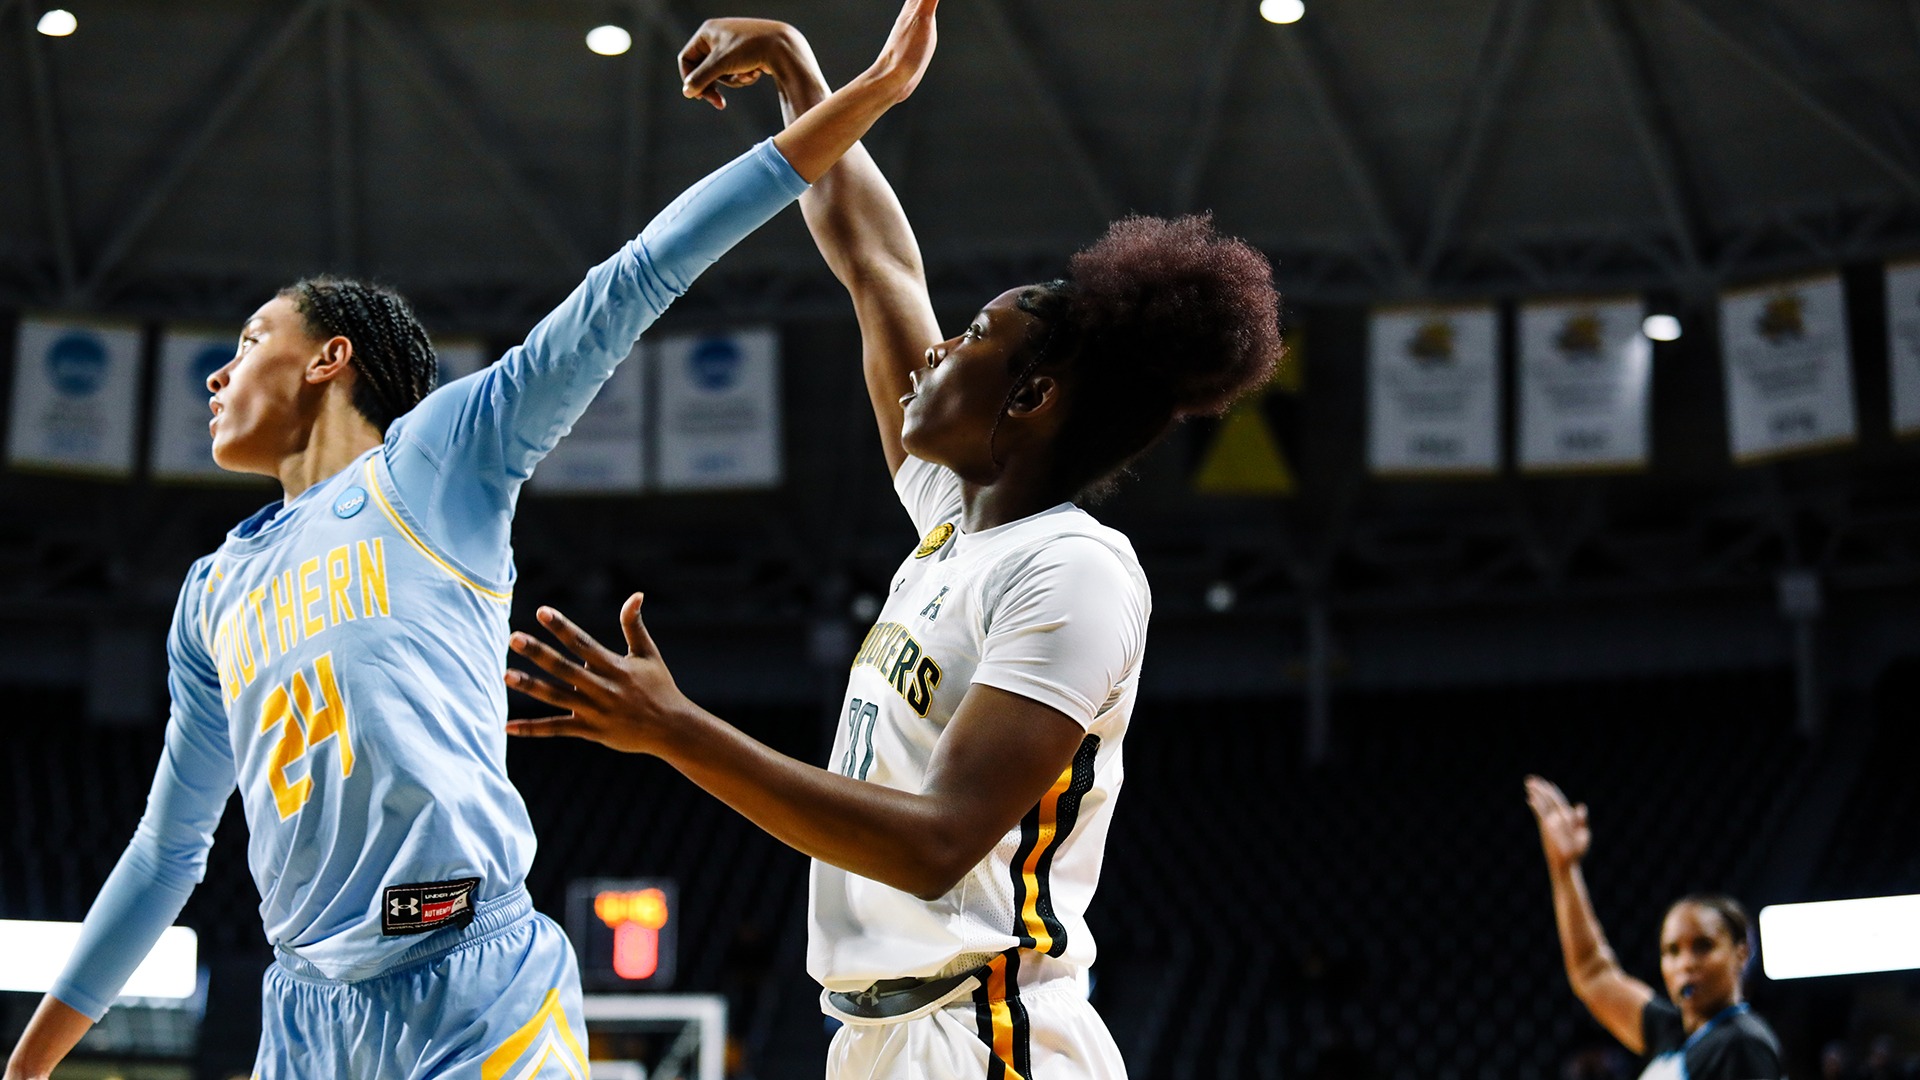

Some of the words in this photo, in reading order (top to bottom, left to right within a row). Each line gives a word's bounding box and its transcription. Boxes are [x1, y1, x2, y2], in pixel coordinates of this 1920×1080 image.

[337, 495, 365, 513] NCAA
[851, 621, 943, 719] OCKERS
[259, 650, 356, 824] 24
[424, 906, 451, 918] AUTHEN
